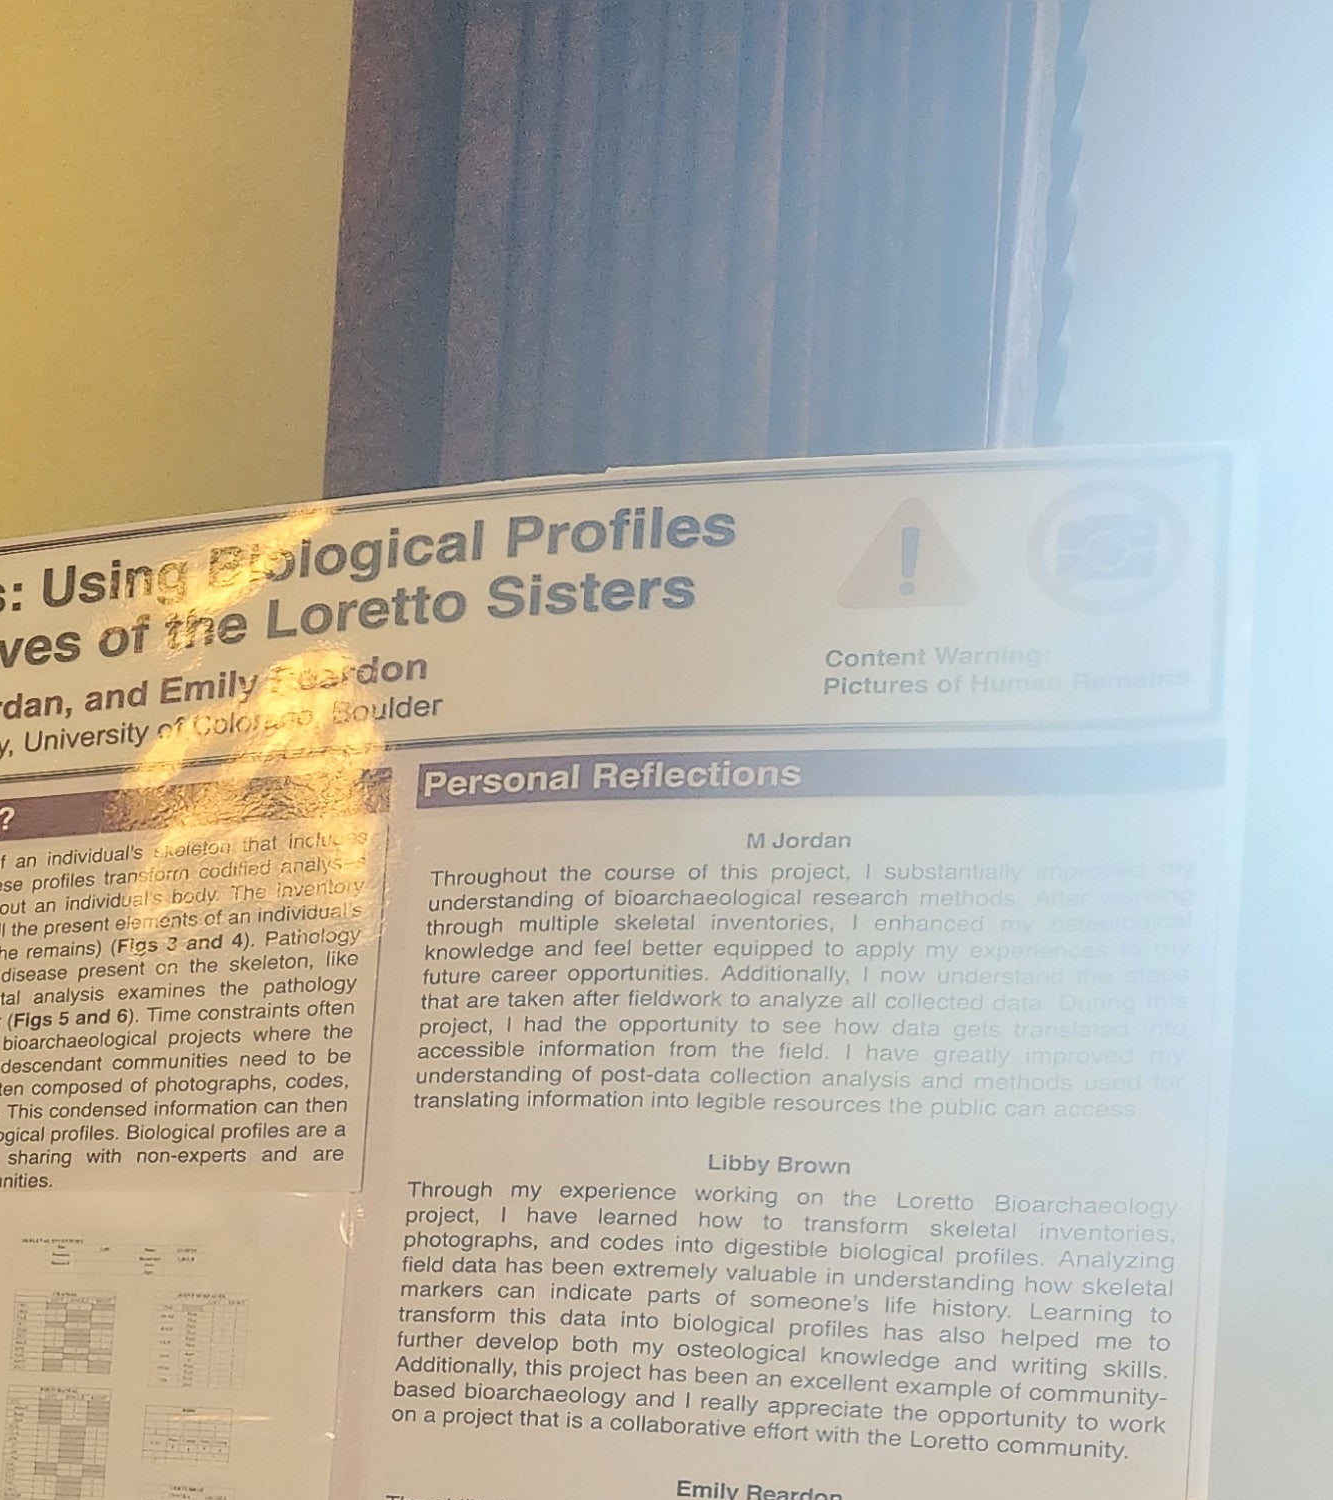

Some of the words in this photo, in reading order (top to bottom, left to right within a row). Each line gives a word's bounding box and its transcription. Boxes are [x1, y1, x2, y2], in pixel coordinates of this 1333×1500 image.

[43, 558, 189, 607] Using
[209, 519, 484, 588] Biological
[507, 505, 737, 558] Profiles
[99, 614, 151, 658] of
[166, 608, 247, 651] the
[267, 585, 467, 640] Loretto
[487, 572, 696, 620] Sisters
[825, 648, 926, 669] Content
[85, 679, 147, 712] and
[160, 669, 257, 706] Emily
[824, 675, 928, 696] Pictures
[937, 675, 964, 694] of
[24, 721, 149, 753] University
[157, 715, 187, 740] of
[332, 696, 443, 724] Boulder
[423, 763, 580, 798] Personal
[593, 759, 802, 790] Reflections
[746, 832, 766, 849] M
[772, 832, 852, 851] Jordan
[708, 1154, 770, 1176] Libby
[777, 1156, 851, 1175] Brown
[391, 1409, 416, 1425] on
[423, 1410, 436, 1425] a
[442, 1406, 513, 1429] project
[519, 1409, 559, 1429] that
[566, 1411, 583, 1430] is
[590, 1416, 603, 1431] a
[610, 1414, 747, 1439] collaborative
[753, 1422, 810, 1443] effort
[816, 1425, 860, 1445] with
[867, 1429, 902, 1448] the
[910, 1430, 989, 1453] Loretto
[997, 1436, 1129, 1464] community.
